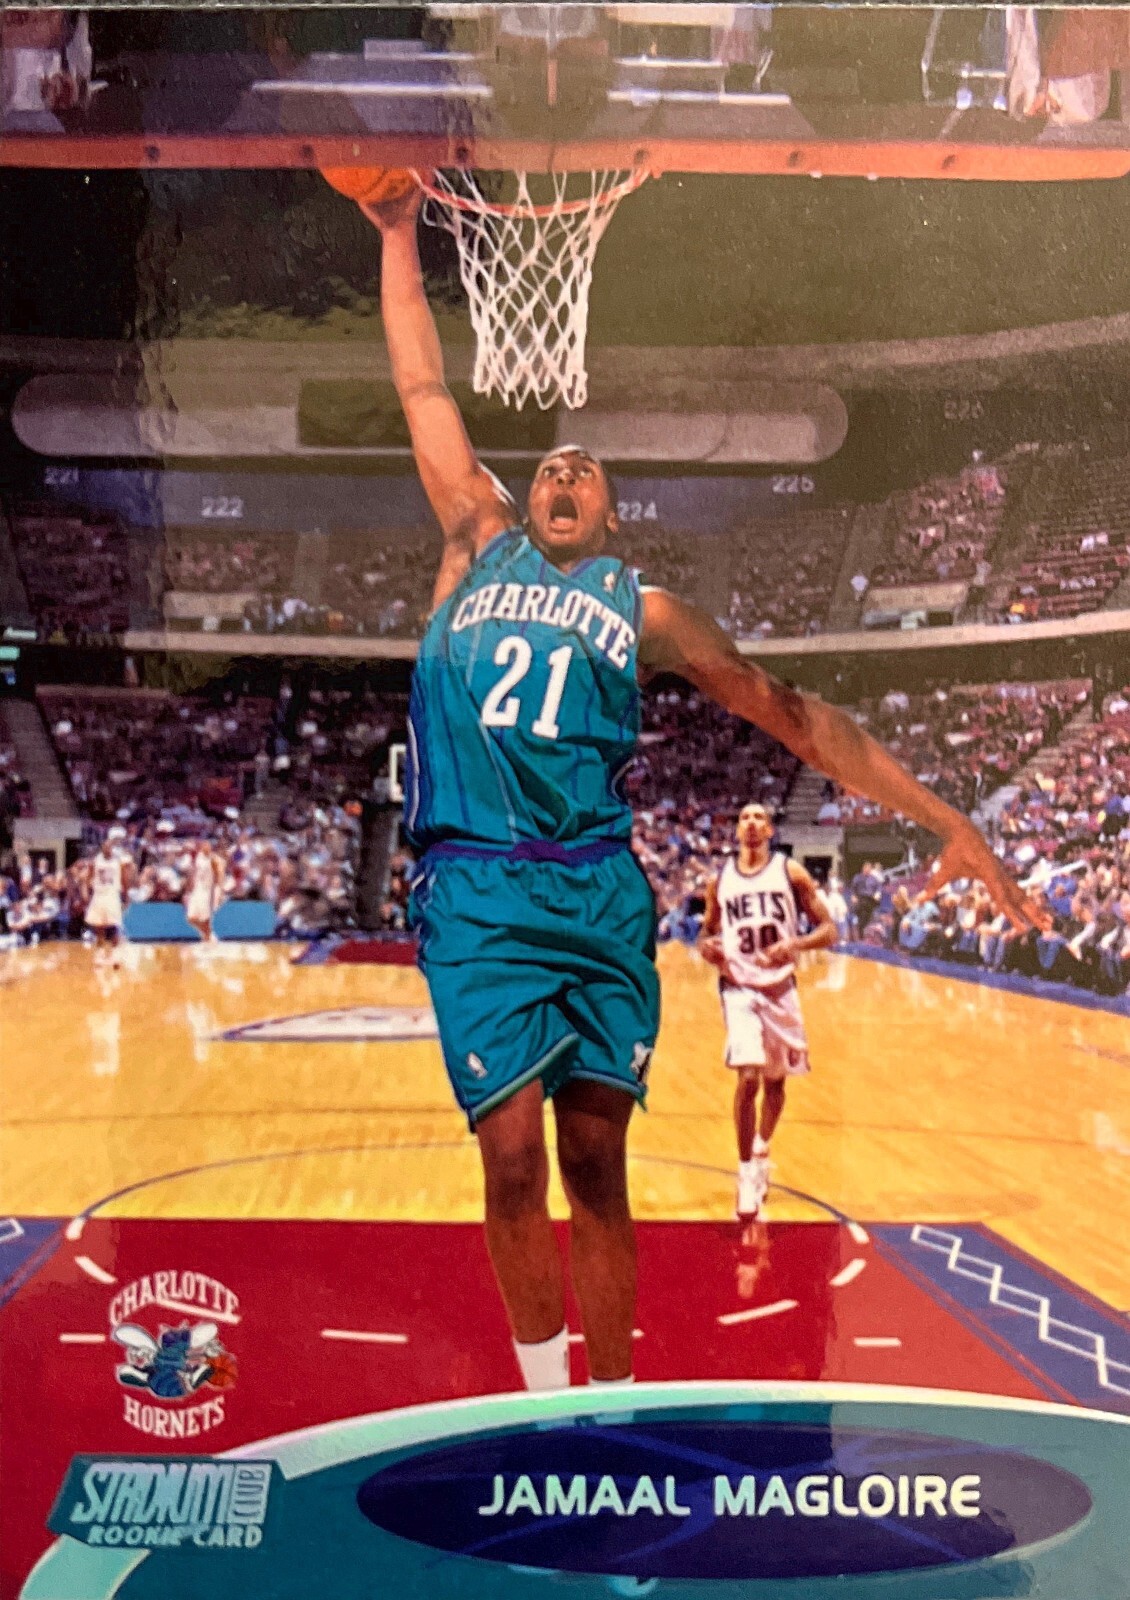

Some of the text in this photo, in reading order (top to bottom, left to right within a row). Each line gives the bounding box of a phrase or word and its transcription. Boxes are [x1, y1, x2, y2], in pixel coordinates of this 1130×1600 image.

[201, 496, 244, 519] 222
[617, 501, 658, 522] 224
[451, 582, 637, 670] CHARLOTTE
[481, 634, 573, 740] 21
[725, 891, 786, 926] NETS
[737, 923, 779, 954] 30
[109, 1270, 240, 1326] CHARLOTTE
[123, 1394, 226, 1438] HORNETS
[233, 1466, 267, 1519] CLUB
[478, 1474, 981, 1517] JAMAAL MAGLOIRE
[87, 1524, 264, 1548] ROOKIE CARD
